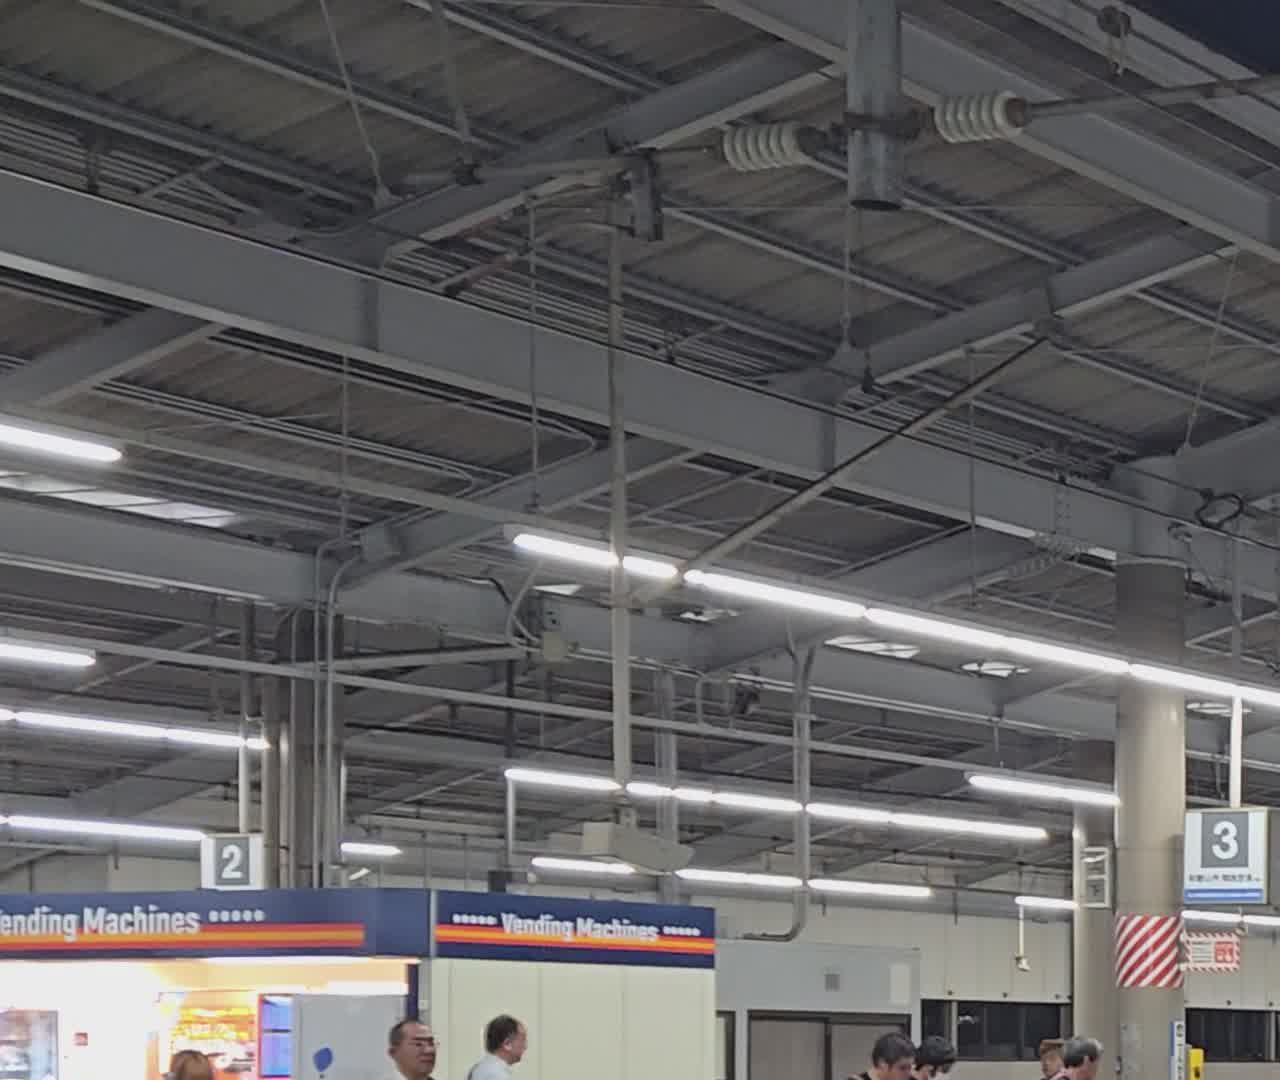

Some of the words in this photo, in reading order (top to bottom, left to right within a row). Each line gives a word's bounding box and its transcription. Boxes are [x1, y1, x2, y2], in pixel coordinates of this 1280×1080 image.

[1211, 819, 1239, 861] 3
[220, 844, 244, 879] 2
[0, 906, 79, 943] ending
[83, 906, 200, 935] Machines
[500, 913, 575, 940] Vending
[576, 917, 659, 942] Machines
